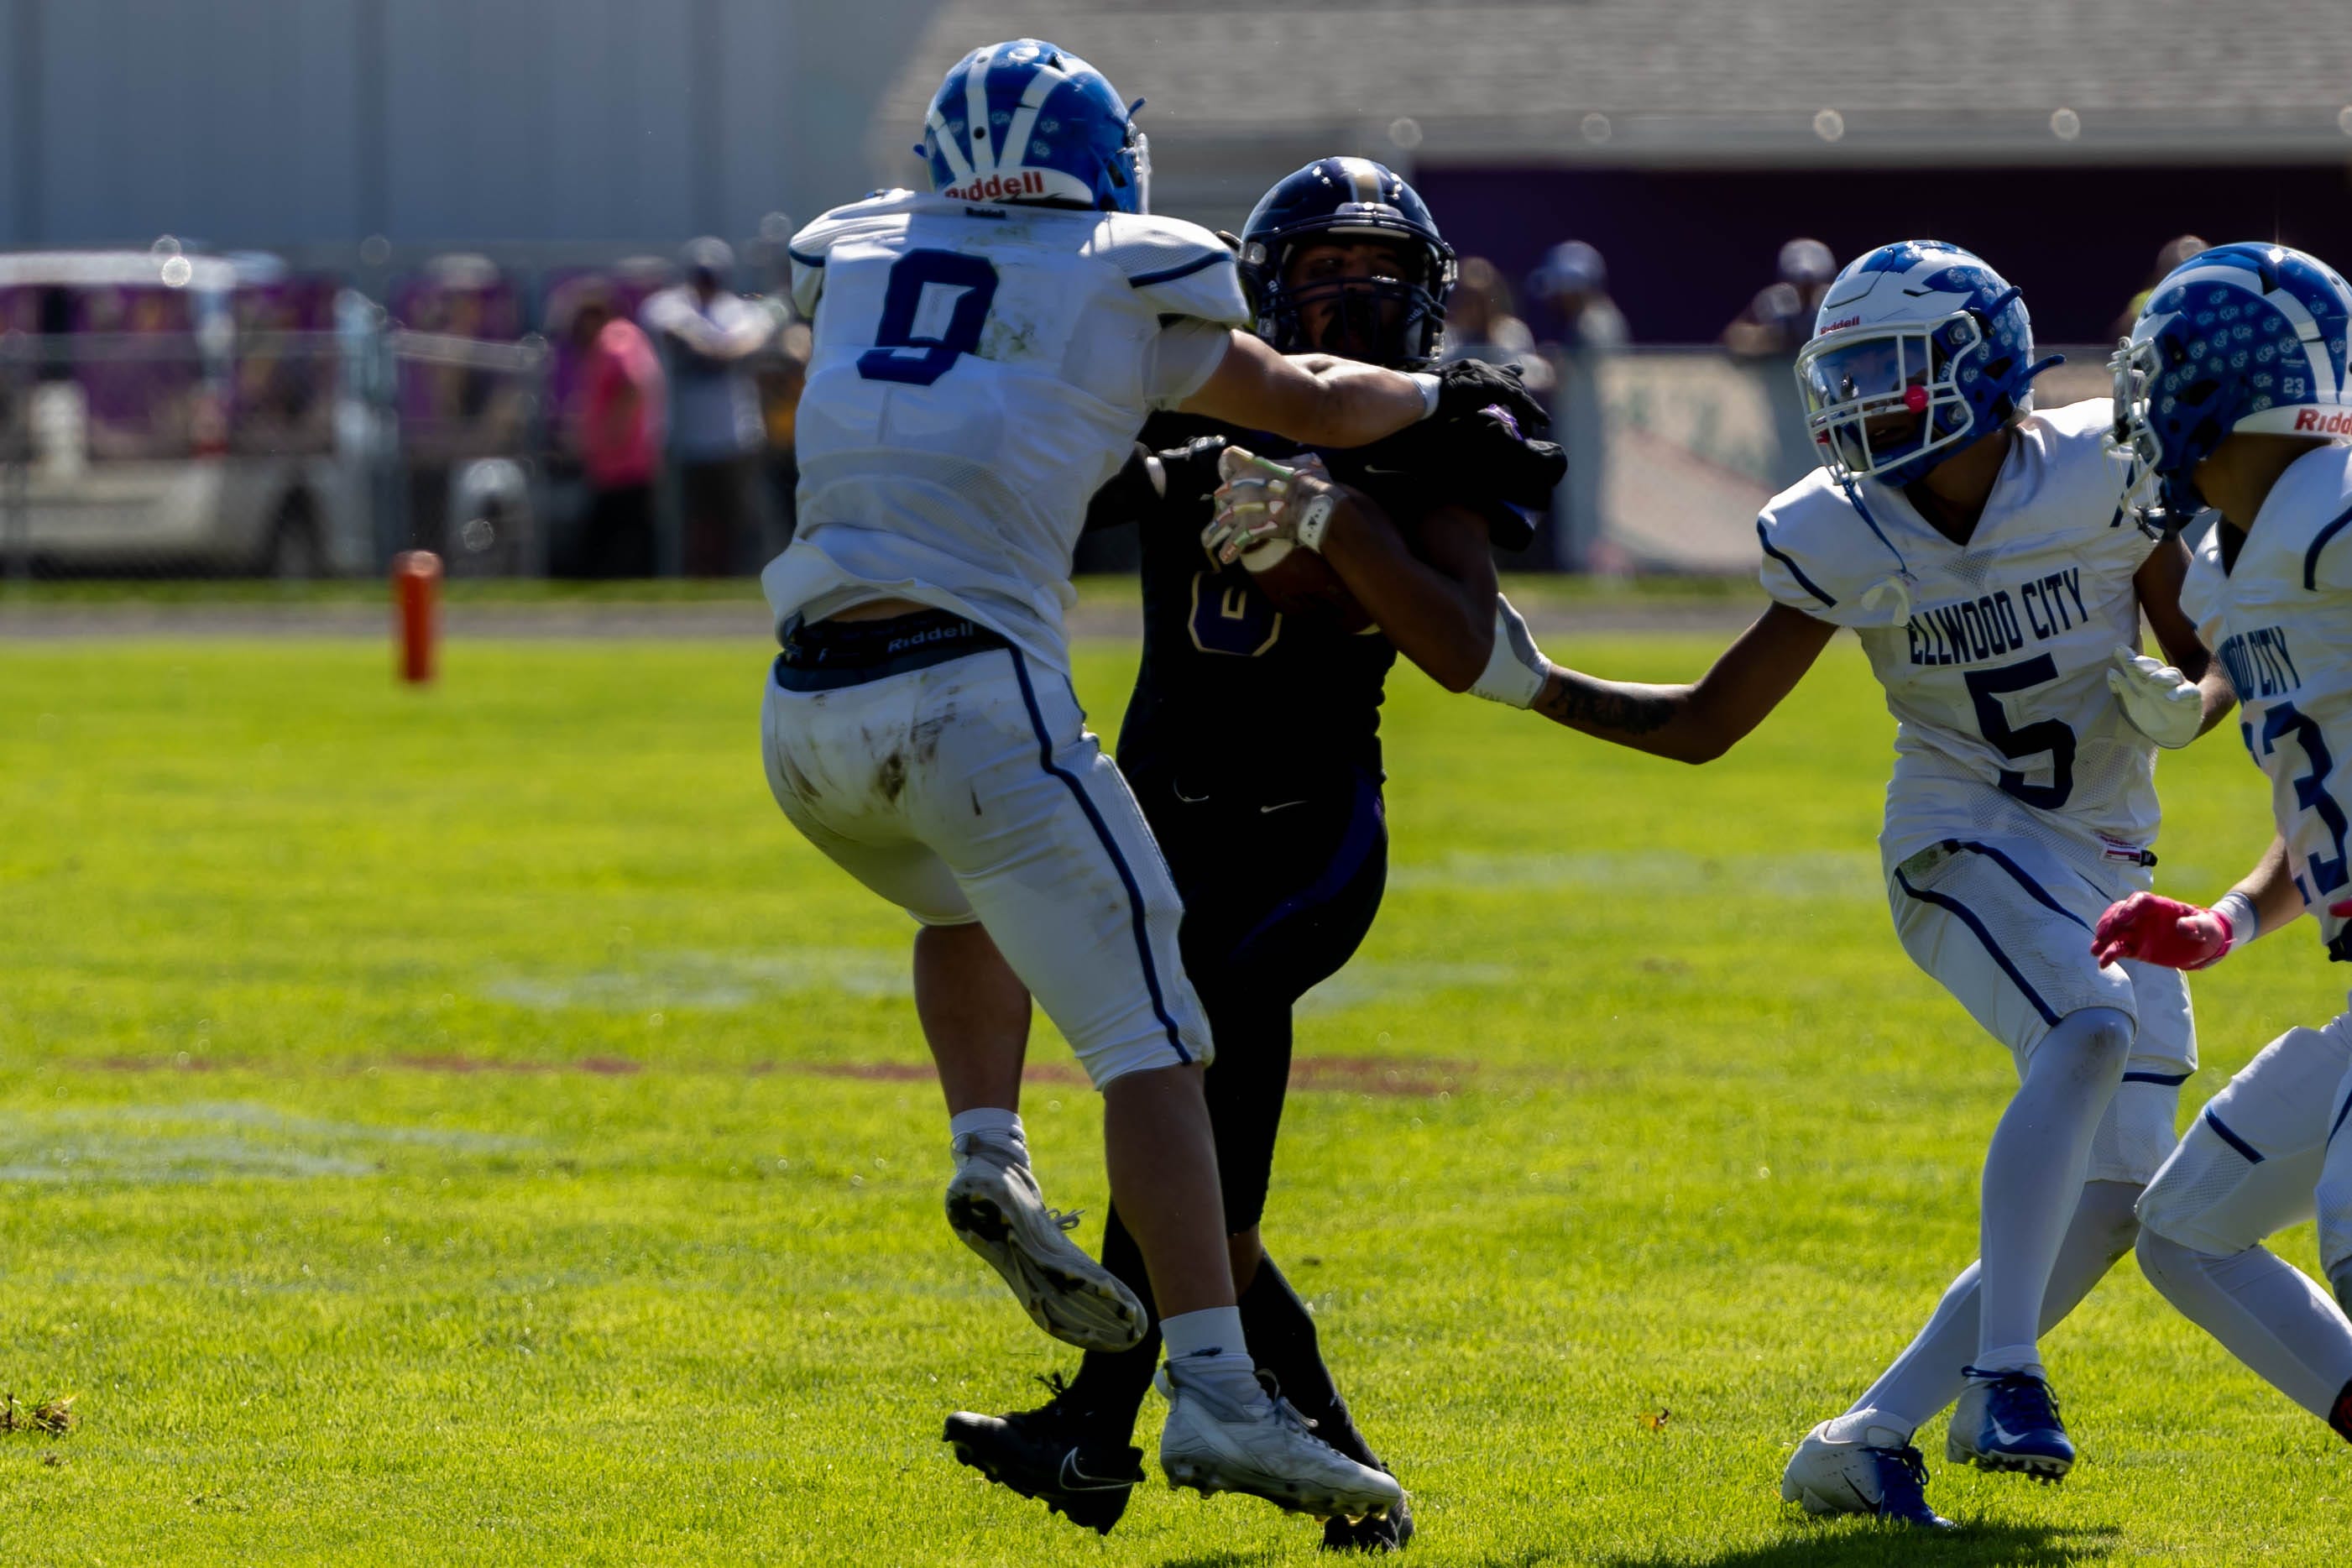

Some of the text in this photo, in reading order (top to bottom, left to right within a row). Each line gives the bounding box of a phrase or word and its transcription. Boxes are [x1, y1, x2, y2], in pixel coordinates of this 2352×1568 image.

[856, 248, 999, 386] 9
[2282, 376, 2305, 398] 23
[886, 622, 975, 654] Riddell
[1908, 567, 2088, 666] ELLWOOD CITY
[2247, 625, 2302, 697] CITY
[1963, 651, 2077, 810] 5
